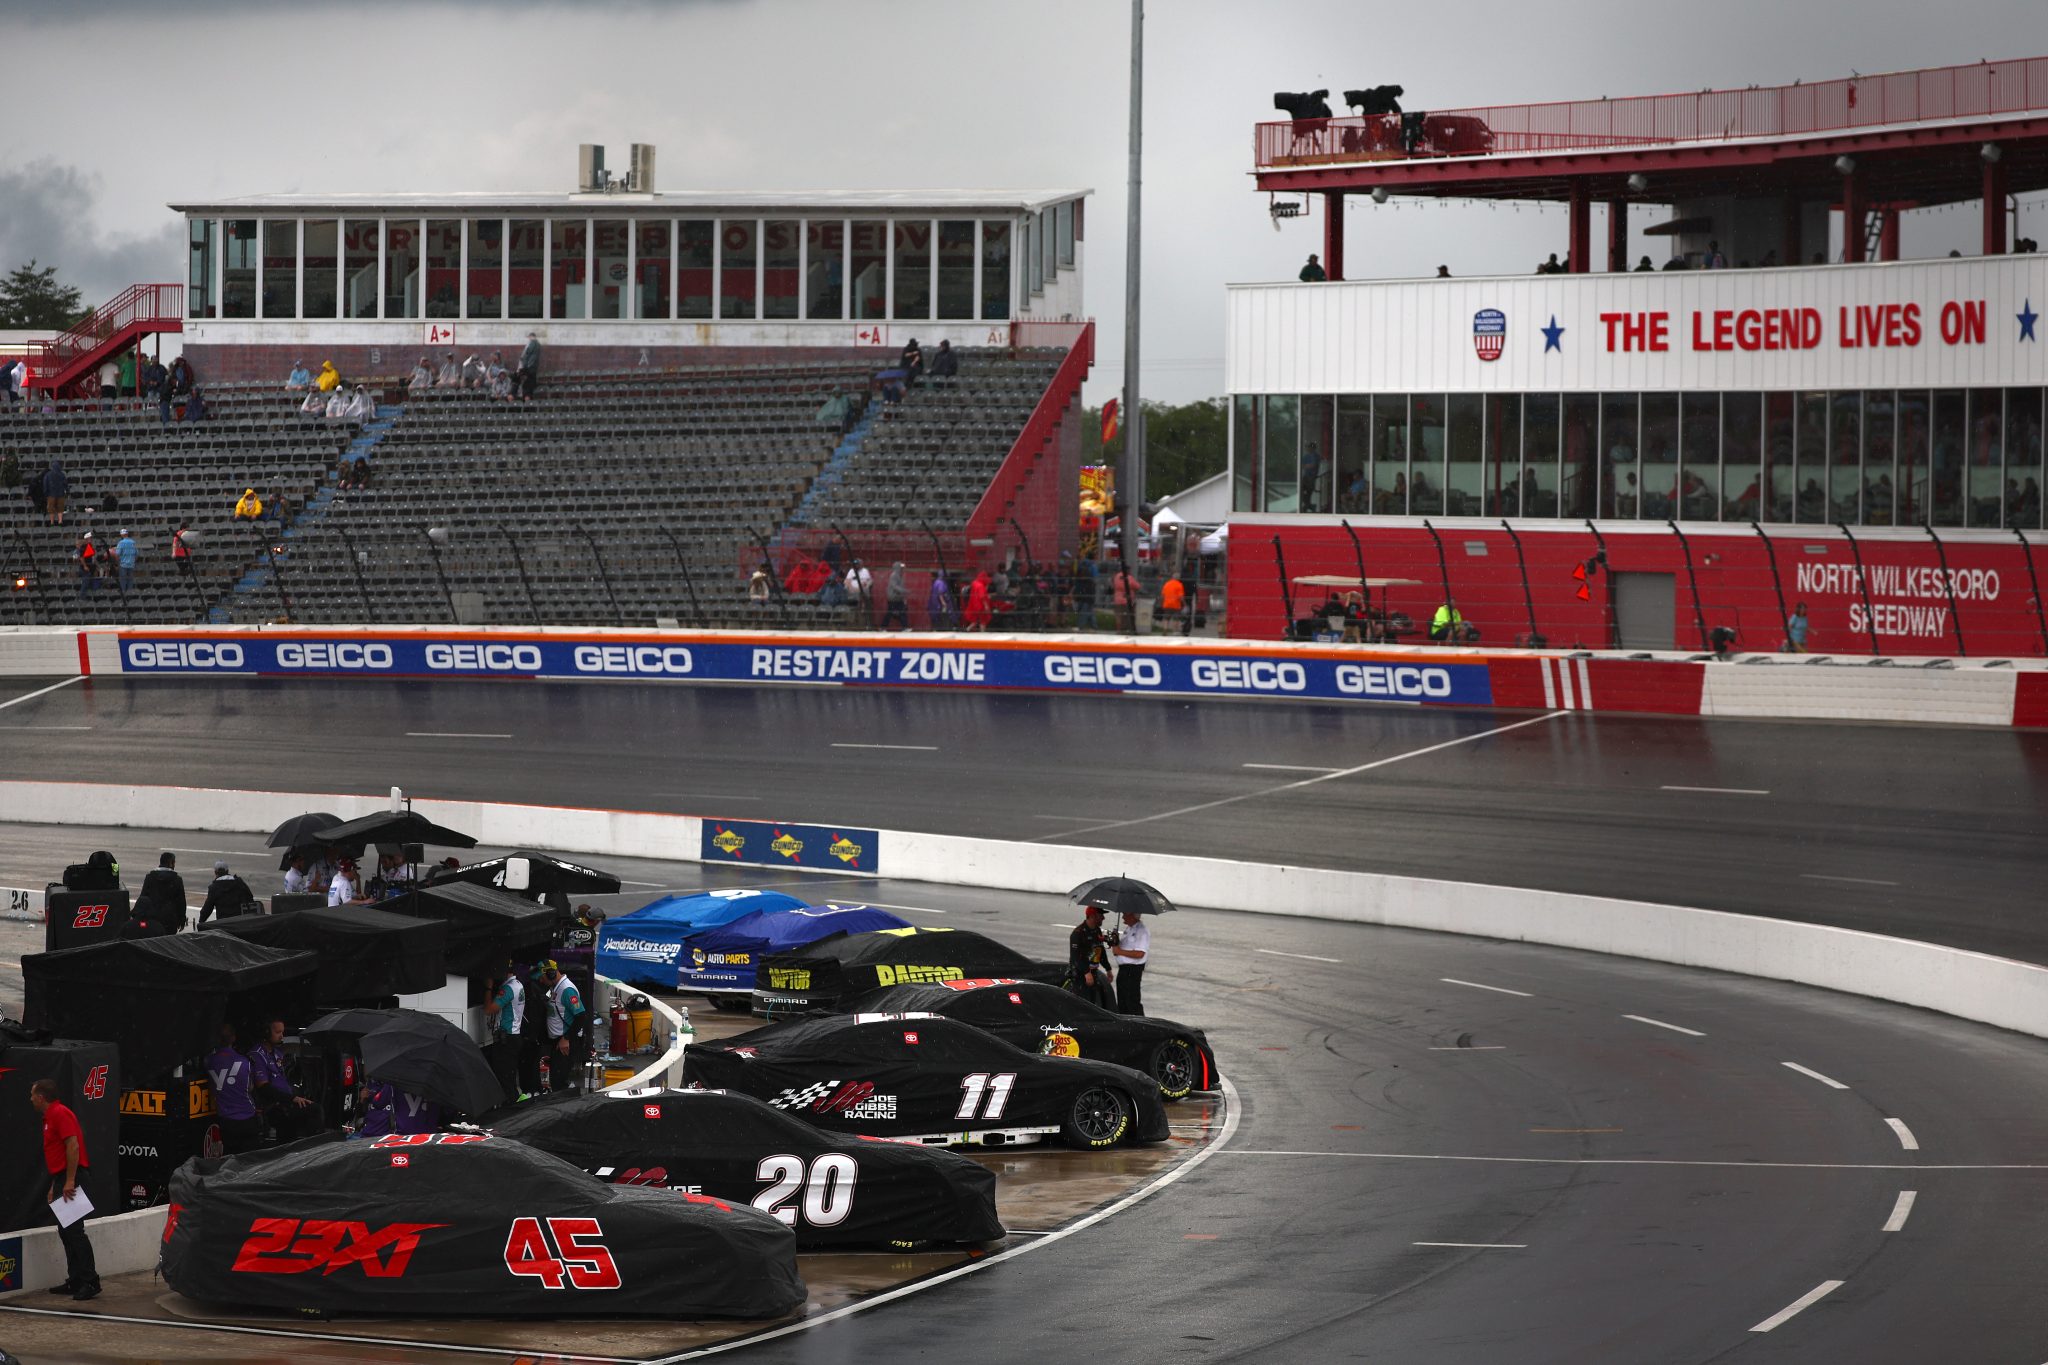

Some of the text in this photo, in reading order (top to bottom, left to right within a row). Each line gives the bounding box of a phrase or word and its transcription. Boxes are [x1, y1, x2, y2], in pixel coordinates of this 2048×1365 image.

[871, 326, 881, 345] A
[1600, 301, 1986, 352] THE LEGEND LIVES ON
[128, 641, 244, 668] GEICO
[276, 642, 393, 669] GEICO
[425, 644, 542, 670] GEICO
[575, 646, 692, 673] GEICO
[751, 648, 985, 682] RESTART ZONE
[1044, 655, 1162, 685] GEICO
[1191, 659, 1306, 691] GEICO
[1335, 664, 1450, 696] GEICO
[714, 836, 744, 847] SUNOCO
[772, 840, 802, 851] SUNOCO
[830, 844, 861, 856] SUNOCO
[73, 904, 109, 928] 23
[707, 953, 725, 964] AUTO
[725, 953, 750, 964] PARTS
[690, 973, 737, 981] CAMARO
[83, 1064, 109, 1100] 45
[855, 1102, 897, 1111] GIBBS
[868, 1095, 897, 1103] JOE
[954, 1072, 1018, 1120] 11
[845, 1111, 897, 1119] RACING
[750, 1152, 859, 1228] 20
[503, 1216, 623, 1290] 45
